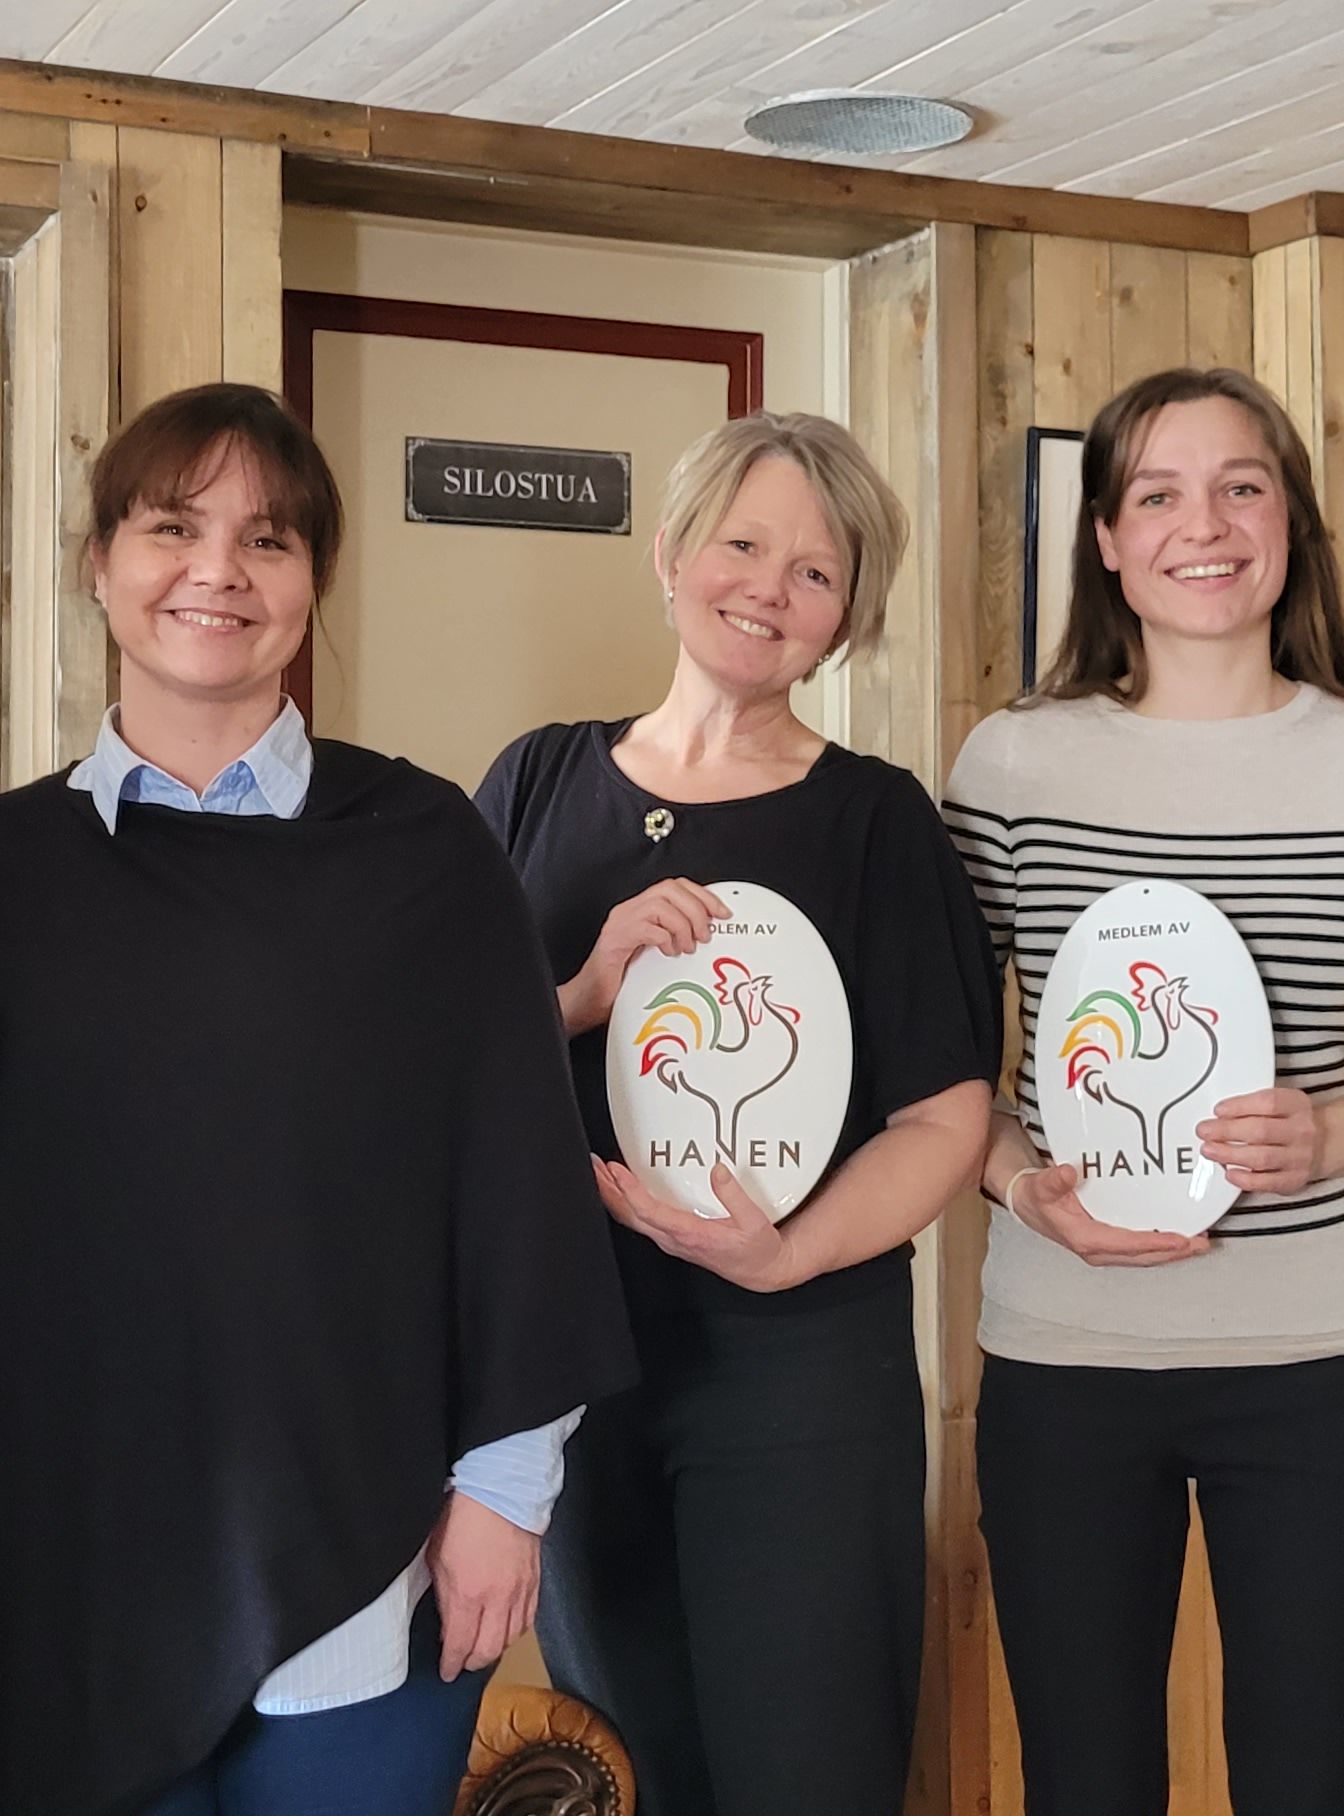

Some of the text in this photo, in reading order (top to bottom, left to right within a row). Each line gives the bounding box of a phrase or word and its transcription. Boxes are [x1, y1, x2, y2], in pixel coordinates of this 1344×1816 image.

[443, 466, 598, 503] SILOSTUA
[708, 923, 778, 935] DLEM AV
[1098, 922, 1190, 941] MEDLEM AV
[649, 1139, 801, 1168] HANEN
[1082, 1147, 1193, 1180] HANE
